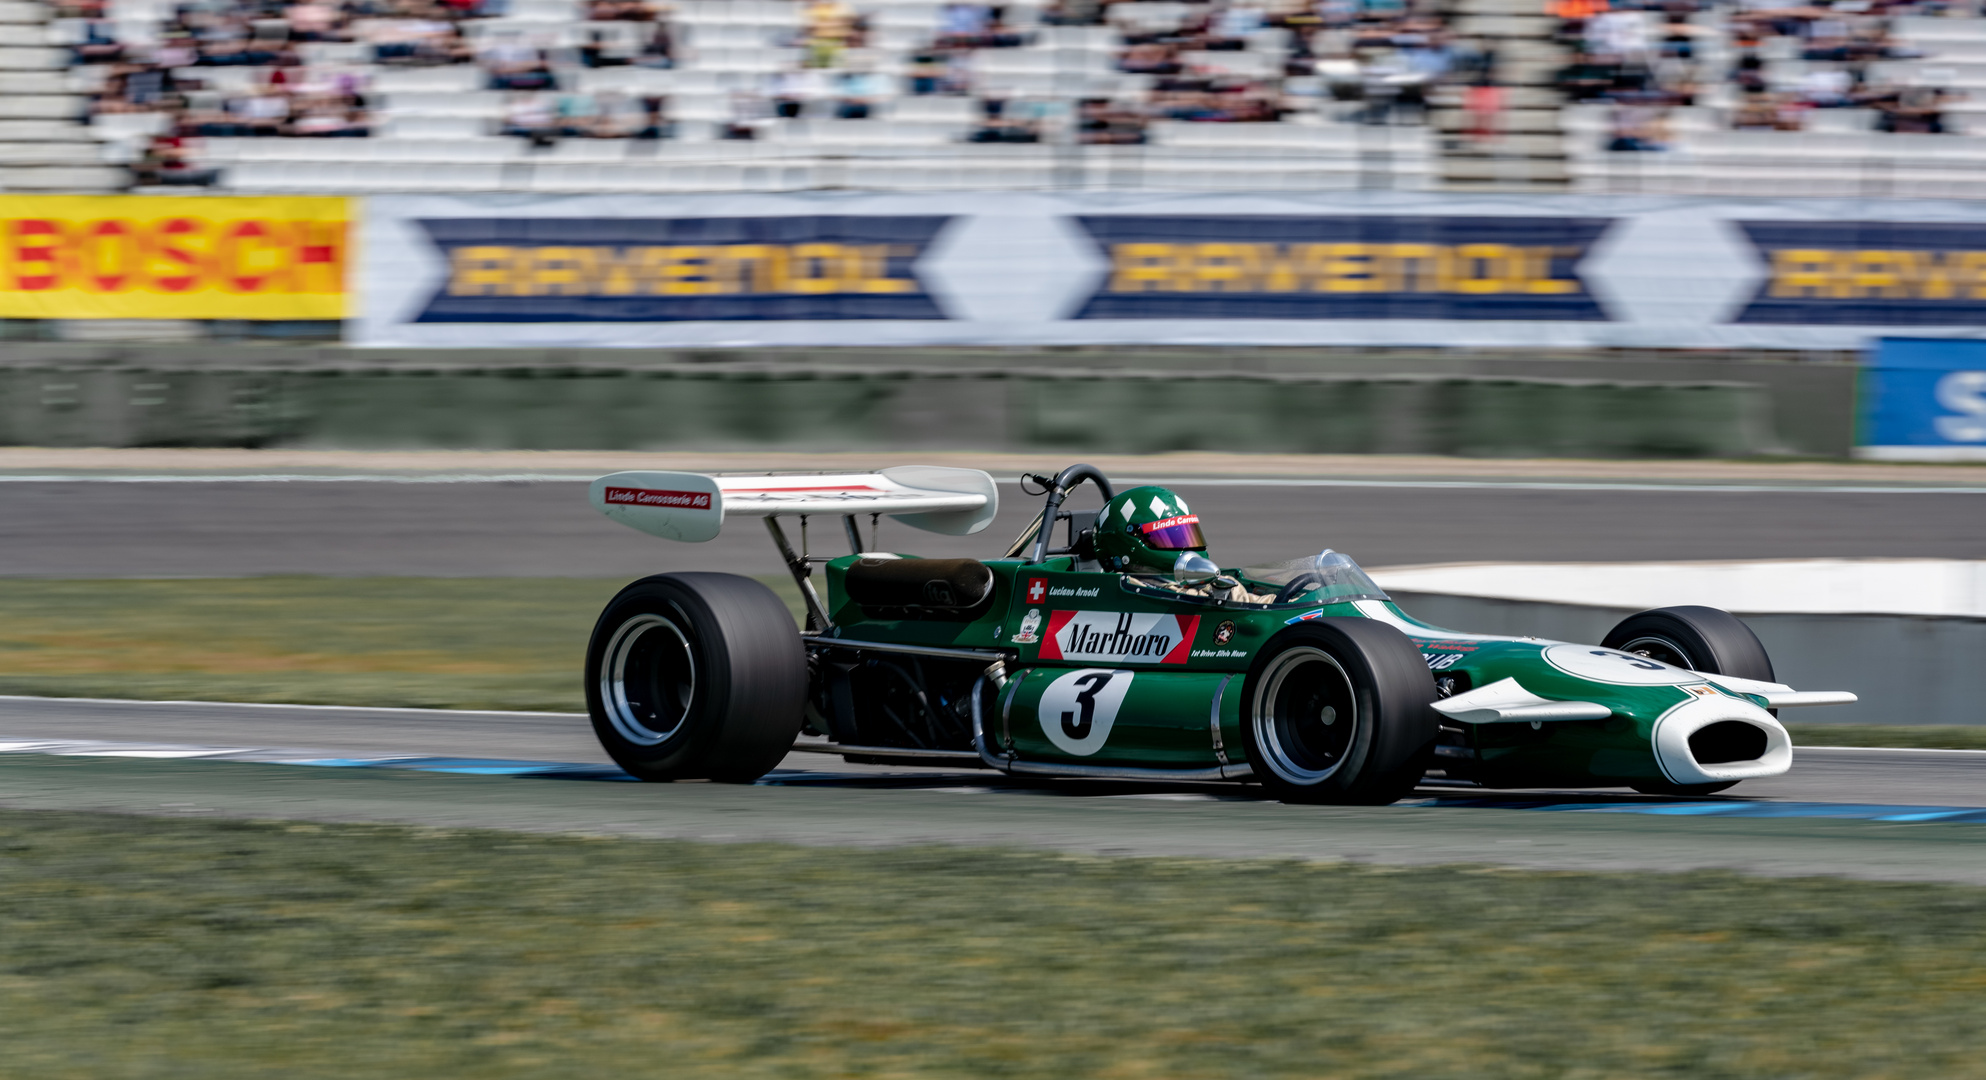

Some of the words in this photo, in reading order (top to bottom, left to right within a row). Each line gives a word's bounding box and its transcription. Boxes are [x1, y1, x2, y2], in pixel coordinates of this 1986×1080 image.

[8, 217, 344, 294] BOSCH
[449, 244, 918, 296] RAVENOL
[1109, 243, 1582, 294] RAVENOL
[1767, 250, 1986, 299] RAV
[608, 490, 636, 502] Linde
[637, 491, 691, 505] Carrosserie
[692, 494, 709, 506] AG
[1152, 519, 1176, 531] Linde
[1049, 586, 1075, 596] Luciano
[1075, 586, 1100, 598] Arnold
[1064, 612, 1171, 657] Marlboro
[1060, 672, 1114, 740] 3
